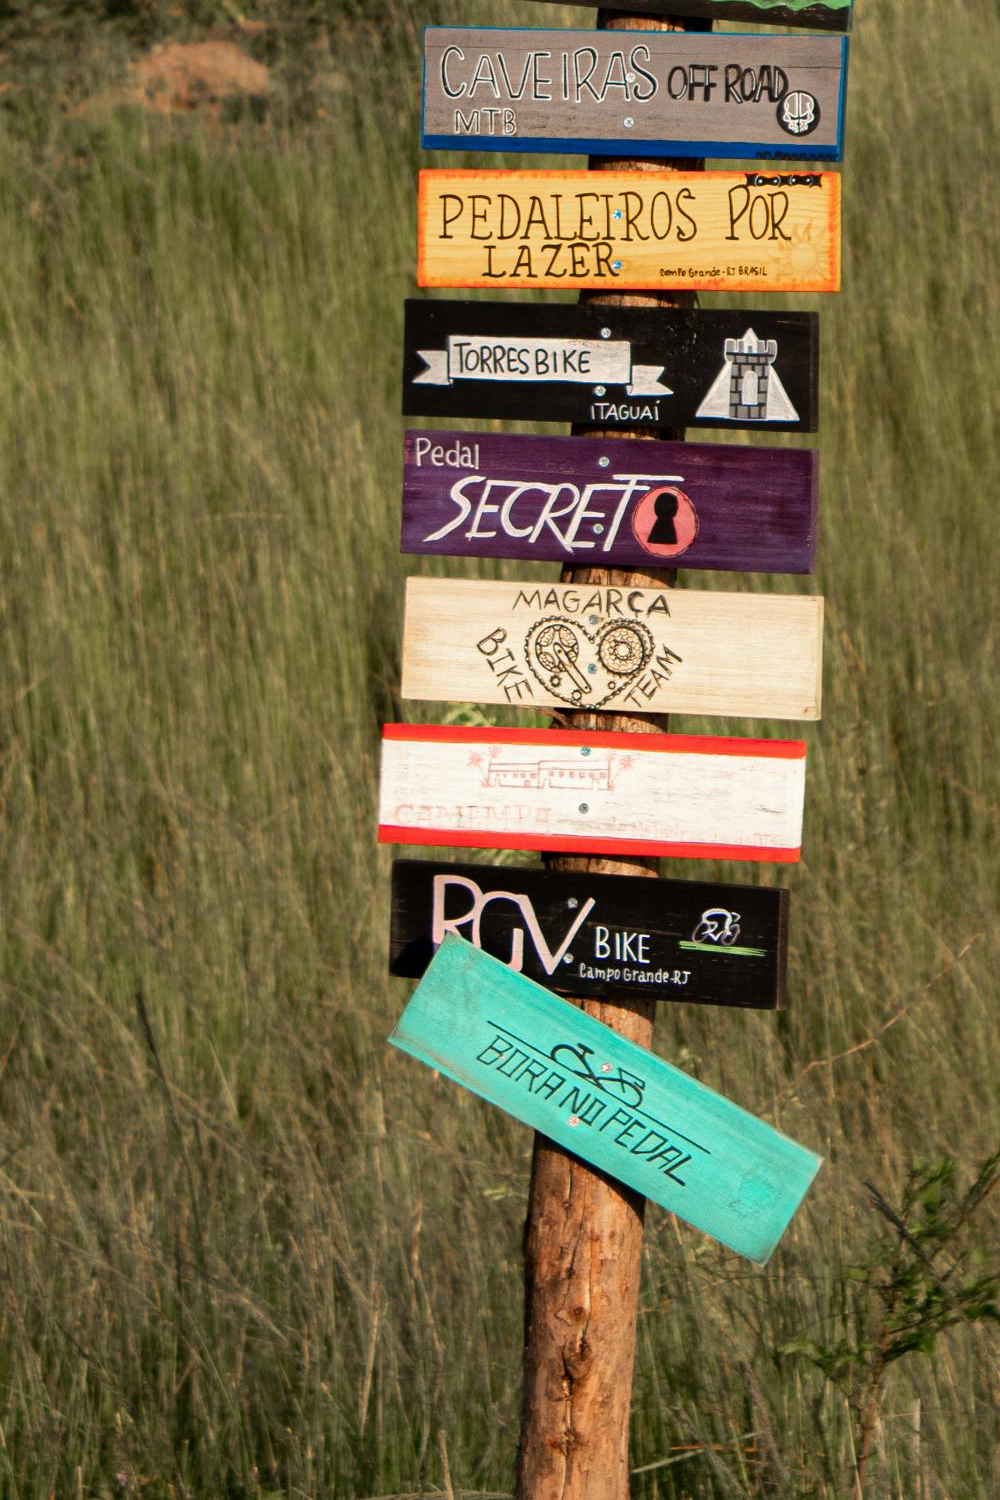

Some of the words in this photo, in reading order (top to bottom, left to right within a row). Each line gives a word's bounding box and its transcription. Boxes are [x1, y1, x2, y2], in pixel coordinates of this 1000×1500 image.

[439, 44, 659, 104] CAVEIRAS
[668, 64, 718, 102] OFF
[724, 64, 789, 105] ROAD
[454, 108, 518, 136] MTB
[439, 187, 697, 241] PEDALEIROS
[725, 184, 792, 241] POR
[482, 241, 620, 279] LAZER
[739, 264, 768, 277] BRASIL
[590, 400, 660, 421] ITAGUAÍ
[415, 438, 479, 470] Pedal
[423, 474, 685, 553] SECRET
[512, 588, 671, 618] MAGARÇA
[476, 627, 534, 703] BIKE
[623, 644, 684, 708] TEAM
[432, 874, 595, 975] RGV
[595, 927, 650, 964] BIKE
[579, 963, 620, 982] Campo
[476, 1034, 567, 1100] BORA
[558, 1087, 607, 1127] NO
[599, 1108, 692, 1187] PEDAL
